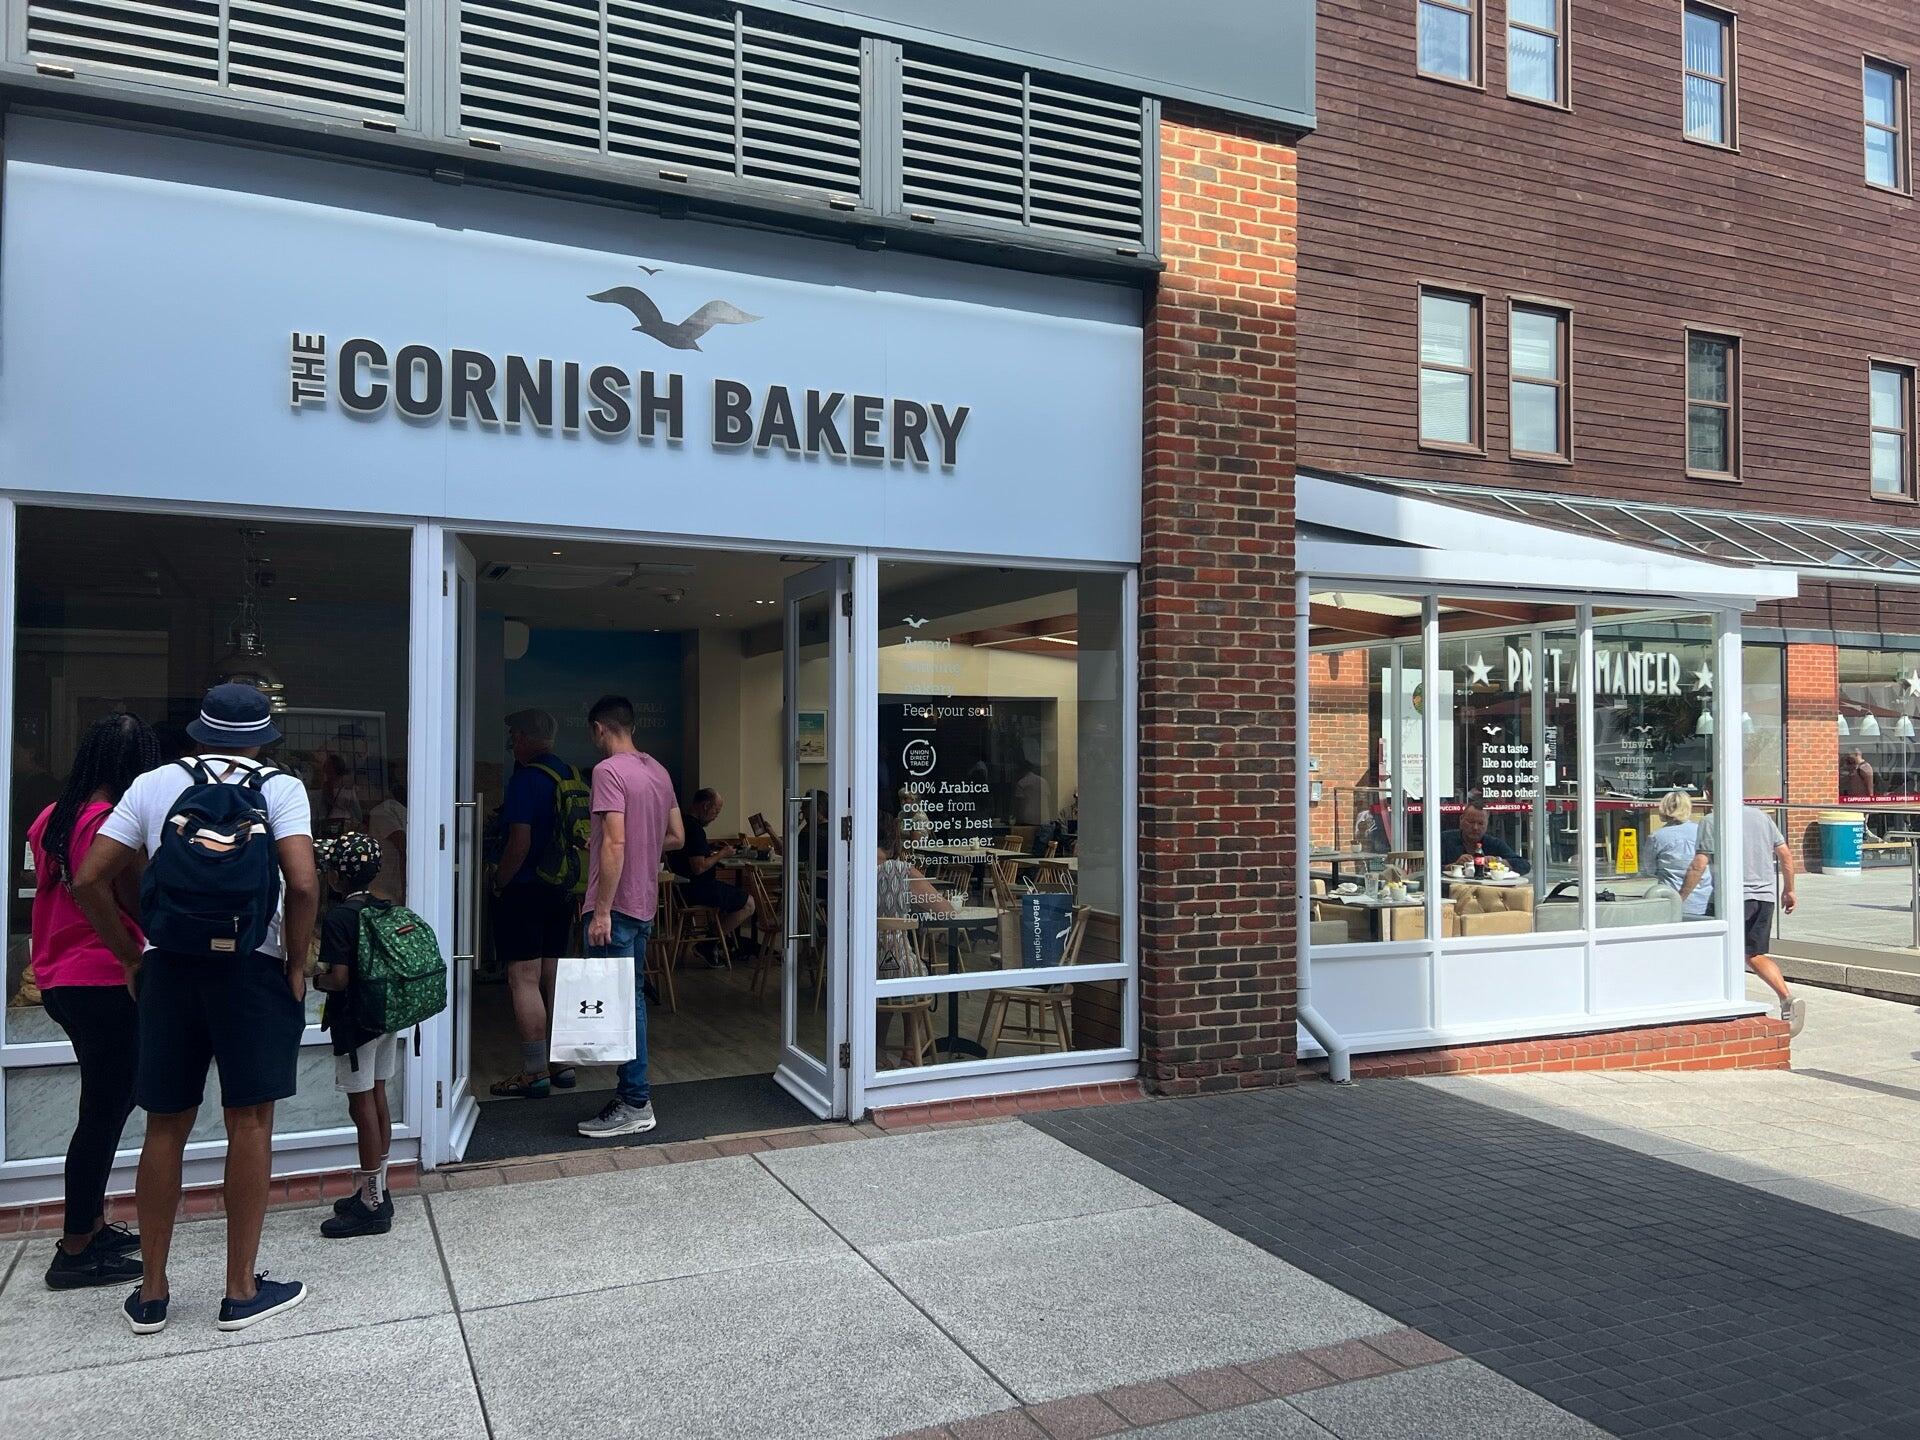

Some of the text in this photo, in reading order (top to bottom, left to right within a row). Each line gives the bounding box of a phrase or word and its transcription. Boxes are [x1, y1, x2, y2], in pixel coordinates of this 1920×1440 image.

[292, 332, 326, 405] THE
[338, 338, 970, 466] CORNISH BAKERY
[1507, 645, 1563, 692] PRT
[1595, 650, 1682, 695] MANGER
[903, 704, 993, 718] Feed your soul
[1482, 743, 1498, 753] For
[1507, 744, 1529, 753] taste
[1482, 758, 1499, 768] like
[1514, 758, 1538, 768] other
[1482, 773, 1539, 785] go to a place
[903, 781, 990, 794] 100% Arabica
[1482, 787, 1499, 797] like
[1514, 787, 1540, 797] other.
[903, 799, 976, 812] coffee from
[903, 817, 993, 832] Europe's best
[903, 836, 995, 849] coffee roaster.
[919, 856, 949, 867] years
[903, 889, 969, 904] Tastes like
[903, 909, 958, 922] nowhere
[1032, 899, 1042, 961] #BeAnOriginal
[368, 1176, 379, 1207] CHICAGO
